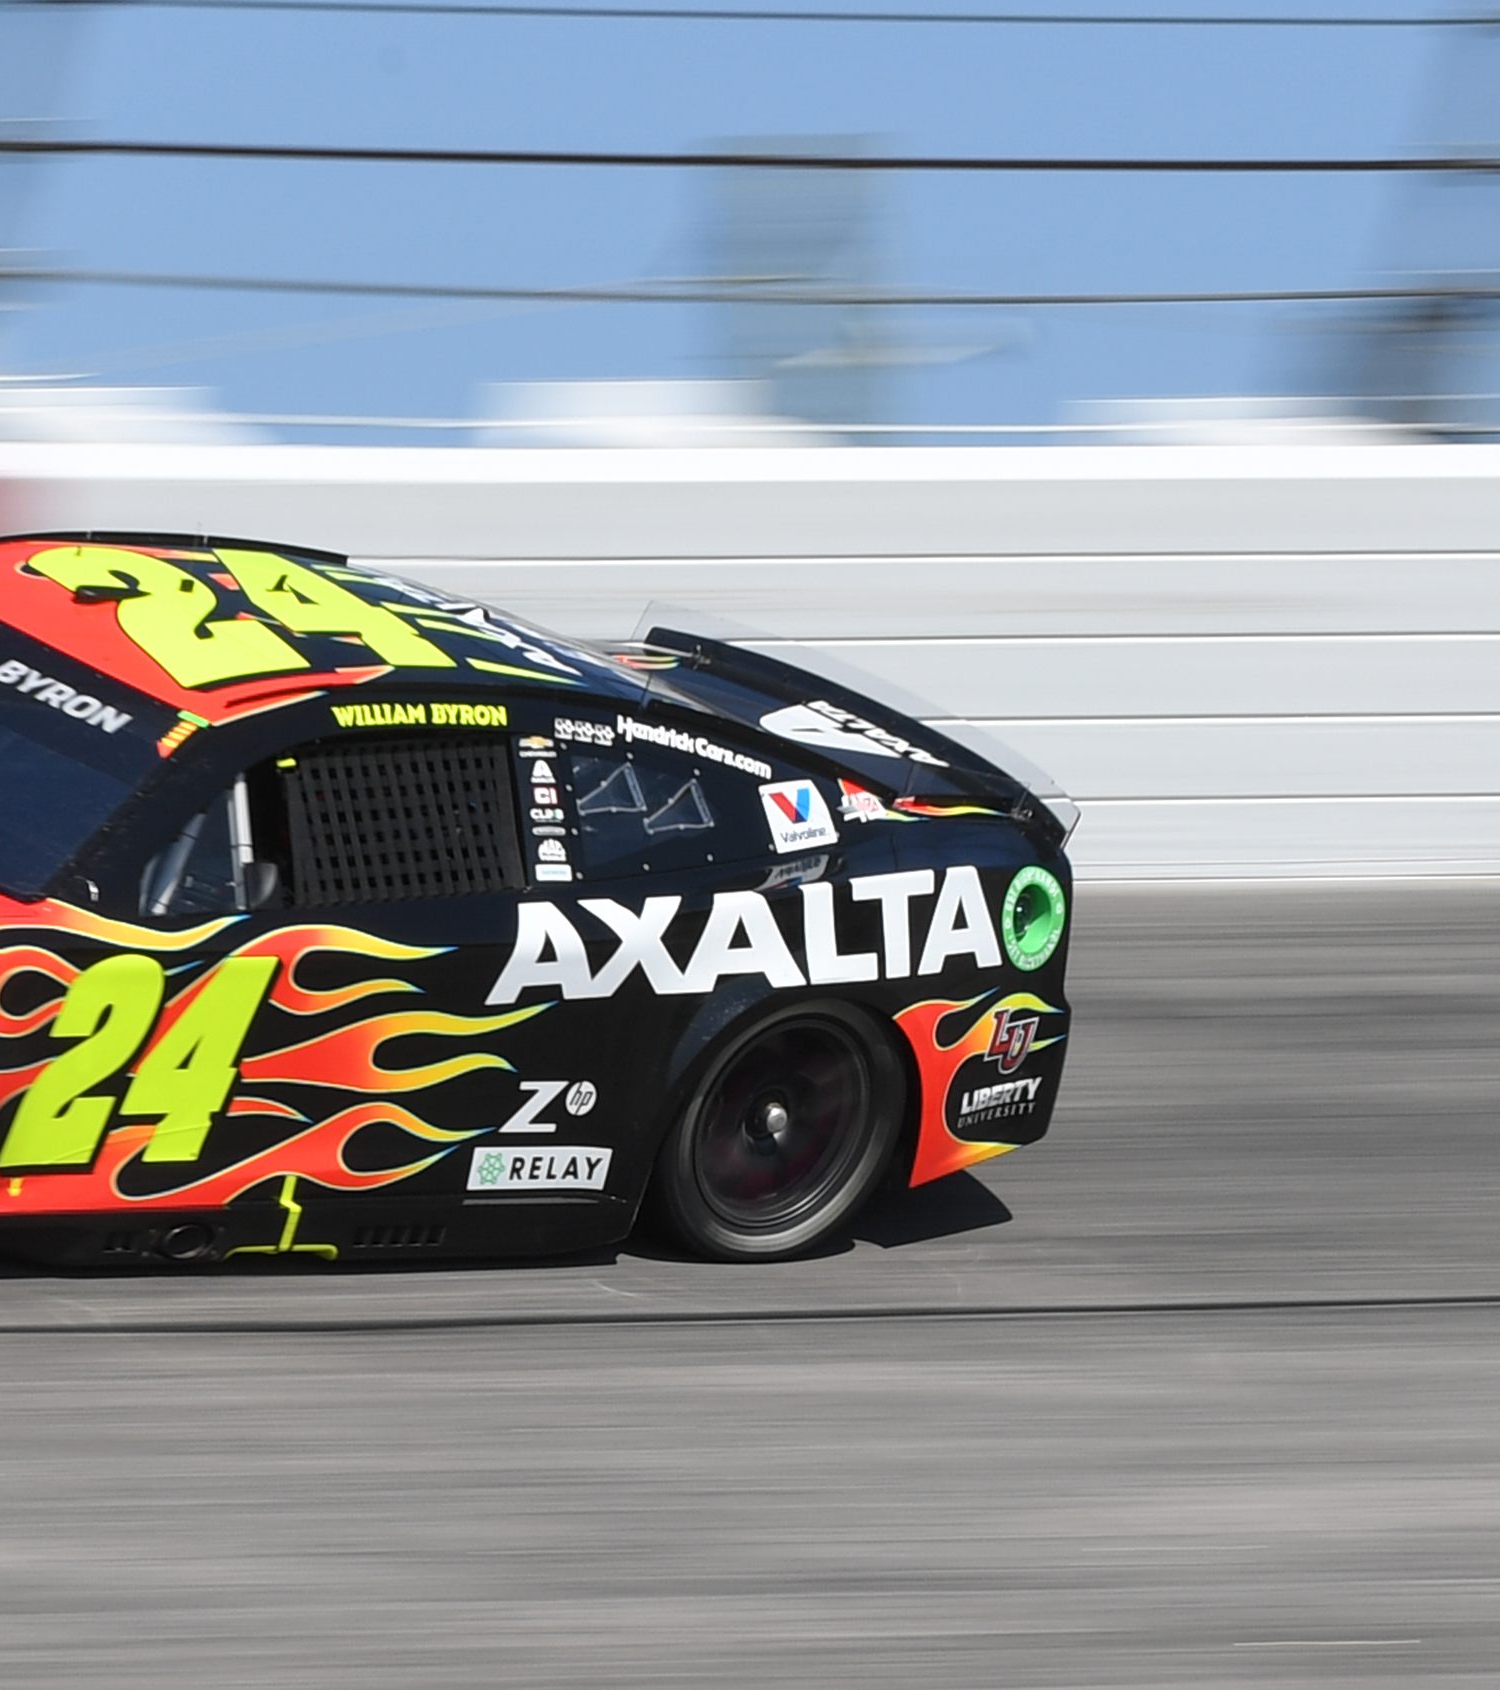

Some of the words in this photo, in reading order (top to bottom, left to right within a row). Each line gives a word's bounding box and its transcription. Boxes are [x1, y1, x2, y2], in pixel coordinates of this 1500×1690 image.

[26, 546, 457, 688] 24
[330, 703, 427, 727] WILLIAM
[430, 703, 507, 727] BYRON
[779, 826, 826, 844] Valvoline
[485, 866, 1002, 1005] AXALTA
[498, 1080, 570, 1133] Z
[568, 1081, 595, 1116] hp
[960, 1076, 1043, 1115] LIBERTY
[957, 1102, 1036, 1129] UNIVERSITY
[508, 1156, 603, 1181] RELAY
